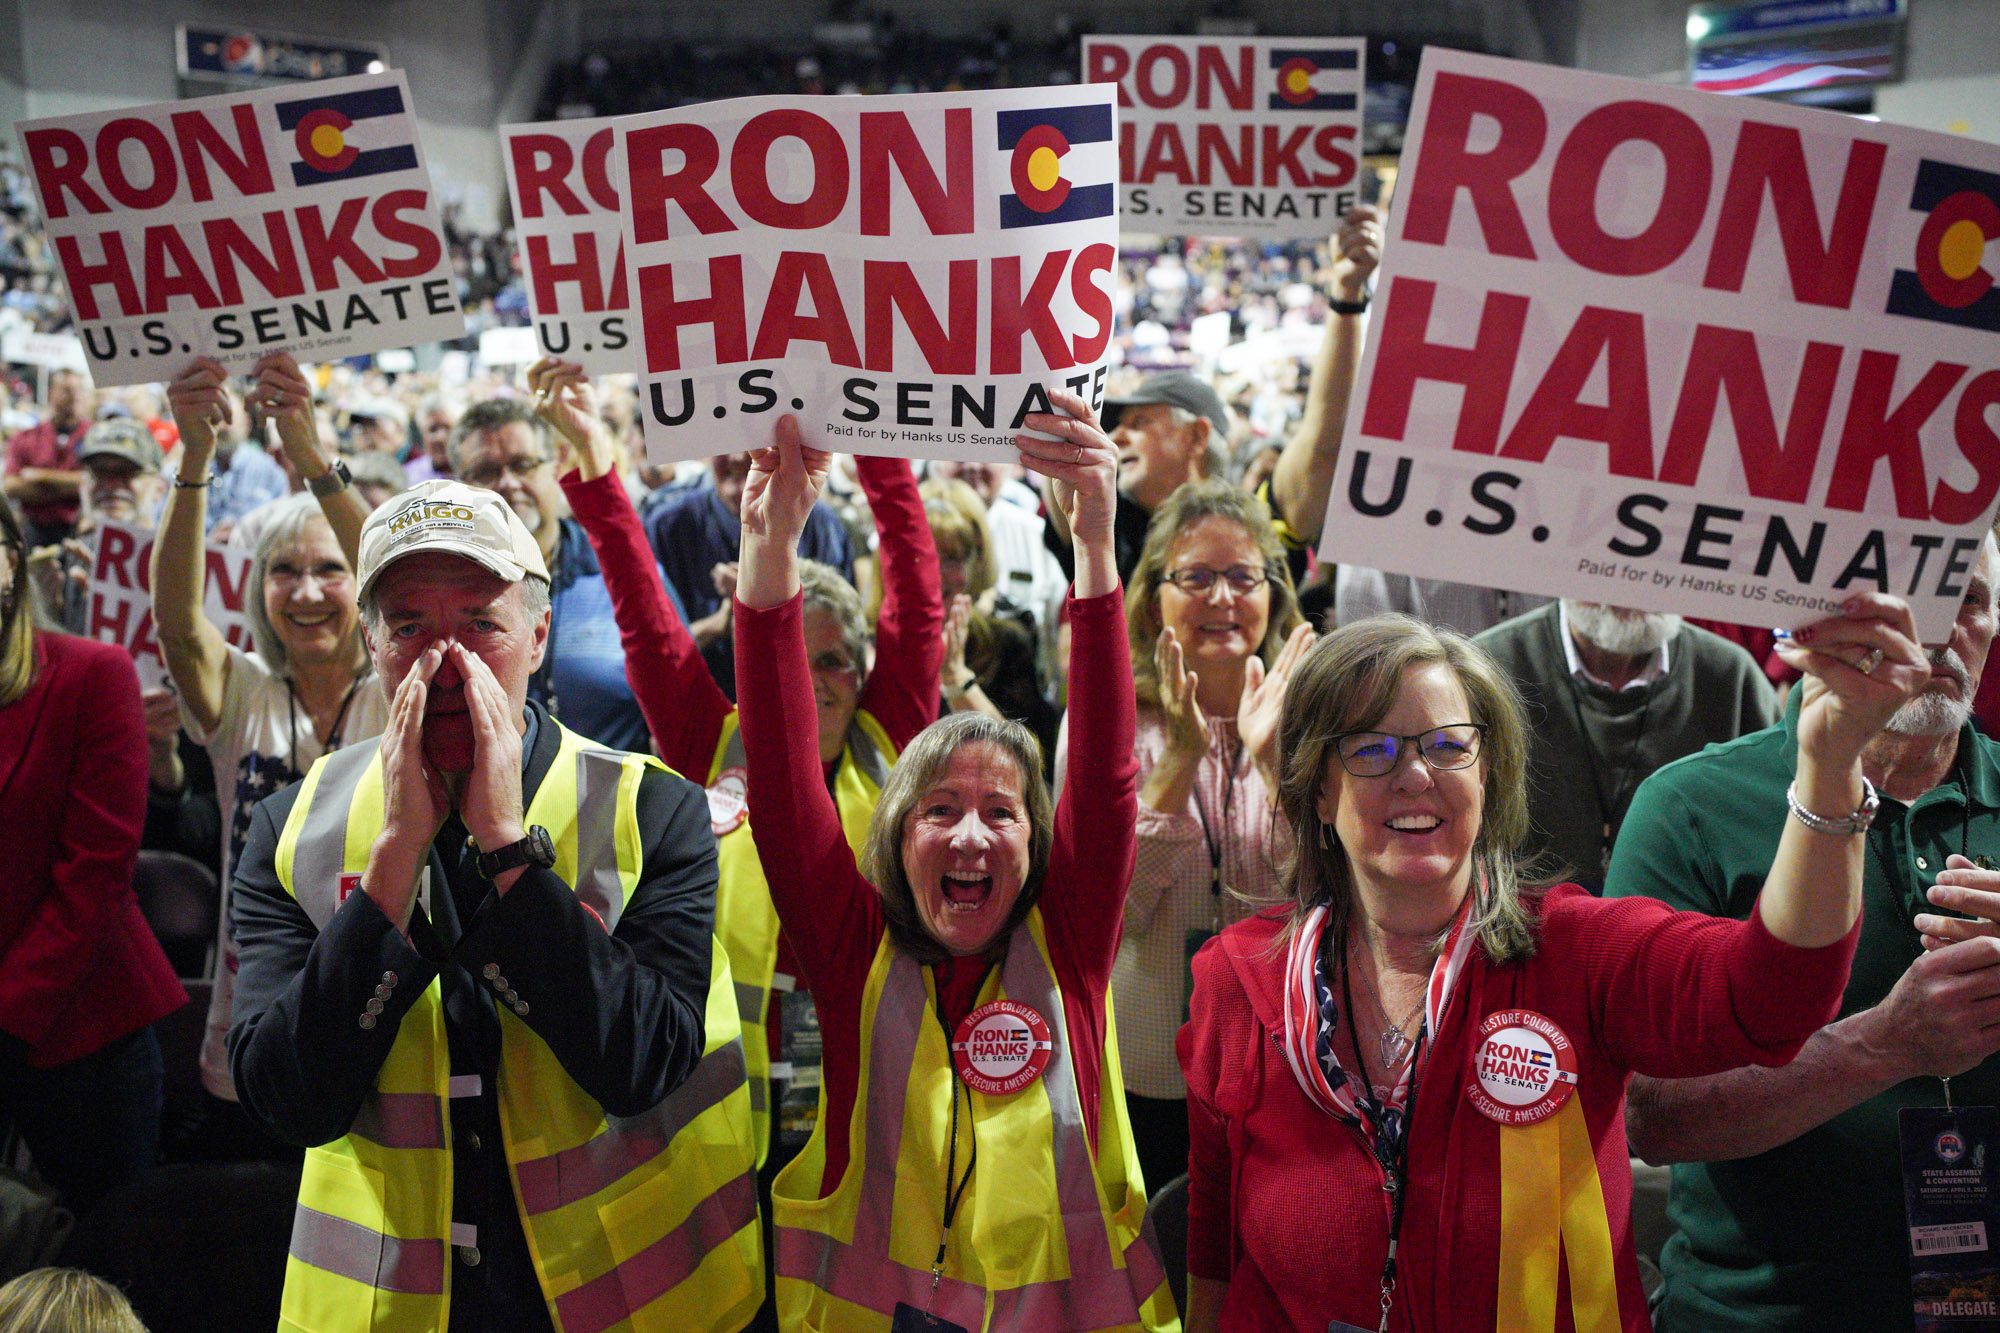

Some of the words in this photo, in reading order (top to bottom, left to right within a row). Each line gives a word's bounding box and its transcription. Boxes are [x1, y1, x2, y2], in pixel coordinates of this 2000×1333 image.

[1088, 44, 1255, 110] RON
[25, 103, 275, 218] RON
[626, 107, 975, 245] RON
[1185, 190, 1355, 219] SENATE
[1400, 70, 1887, 310] RON
[55, 189, 442, 321] HANKS
[82, 320, 191, 362] U.S.
[211, 278, 456, 350] SENATE
[638, 242, 1116, 376] HANKS
[649, 368, 804, 427] U.S.
[842, 365, 1108, 442] SENATE
[1359, 275, 2000, 525] HANKS
[826, 423, 853, 437] Paid
[858, 427, 877, 438] for
[881, 429, 897, 442] by
[901, 430, 943, 443] Hanks
[947, 433, 966, 444] US
[970, 434, 1016, 446] Senate
[1348, 450, 1550, 543] U.S.
[1607, 493, 1980, 602] SENATE
[96, 525, 251, 612] RN
[1577, 558, 1617, 577] Paid
[1621, 563, 1647, 581] for
[1652, 570, 1675, 588] by
[1680, 576, 1736, 596] Hanks
[1741, 584, 1767, 600] US
[965, 1002, 999, 1026] RESTORE
[1001, 1002, 1040, 1026] COLORADO
[1479, 1012, 1521, 1035] RESTORE
[1523, 1013, 1568, 1050] COLORADO
[972, 1042, 1028, 1056] HANKS
[973, 1029, 1009, 1042] RON
[1485, 1040, 1529, 1064] RON
[962, 1067, 1001, 1091] RE-SECURE
[1004, 1065, 1038, 1091] AMERICA
[1480, 1072, 1500, 1083] U.S.
[1504, 1077, 1547, 1092] SENATE
[1481, 1057, 1550, 1084] HANKS
[1466, 1083, 1512, 1122] RE-SECURE
[1514, 1098, 1558, 1123] AMERICA
[1922, 1169, 1944, 1177] STATE
[1945, 1169, 1982, 1177] ASSEMBLY
[1932, 1177, 1980, 1185] CONVENTION
[1932, 1301, 1997, 1316] DELEGATE
